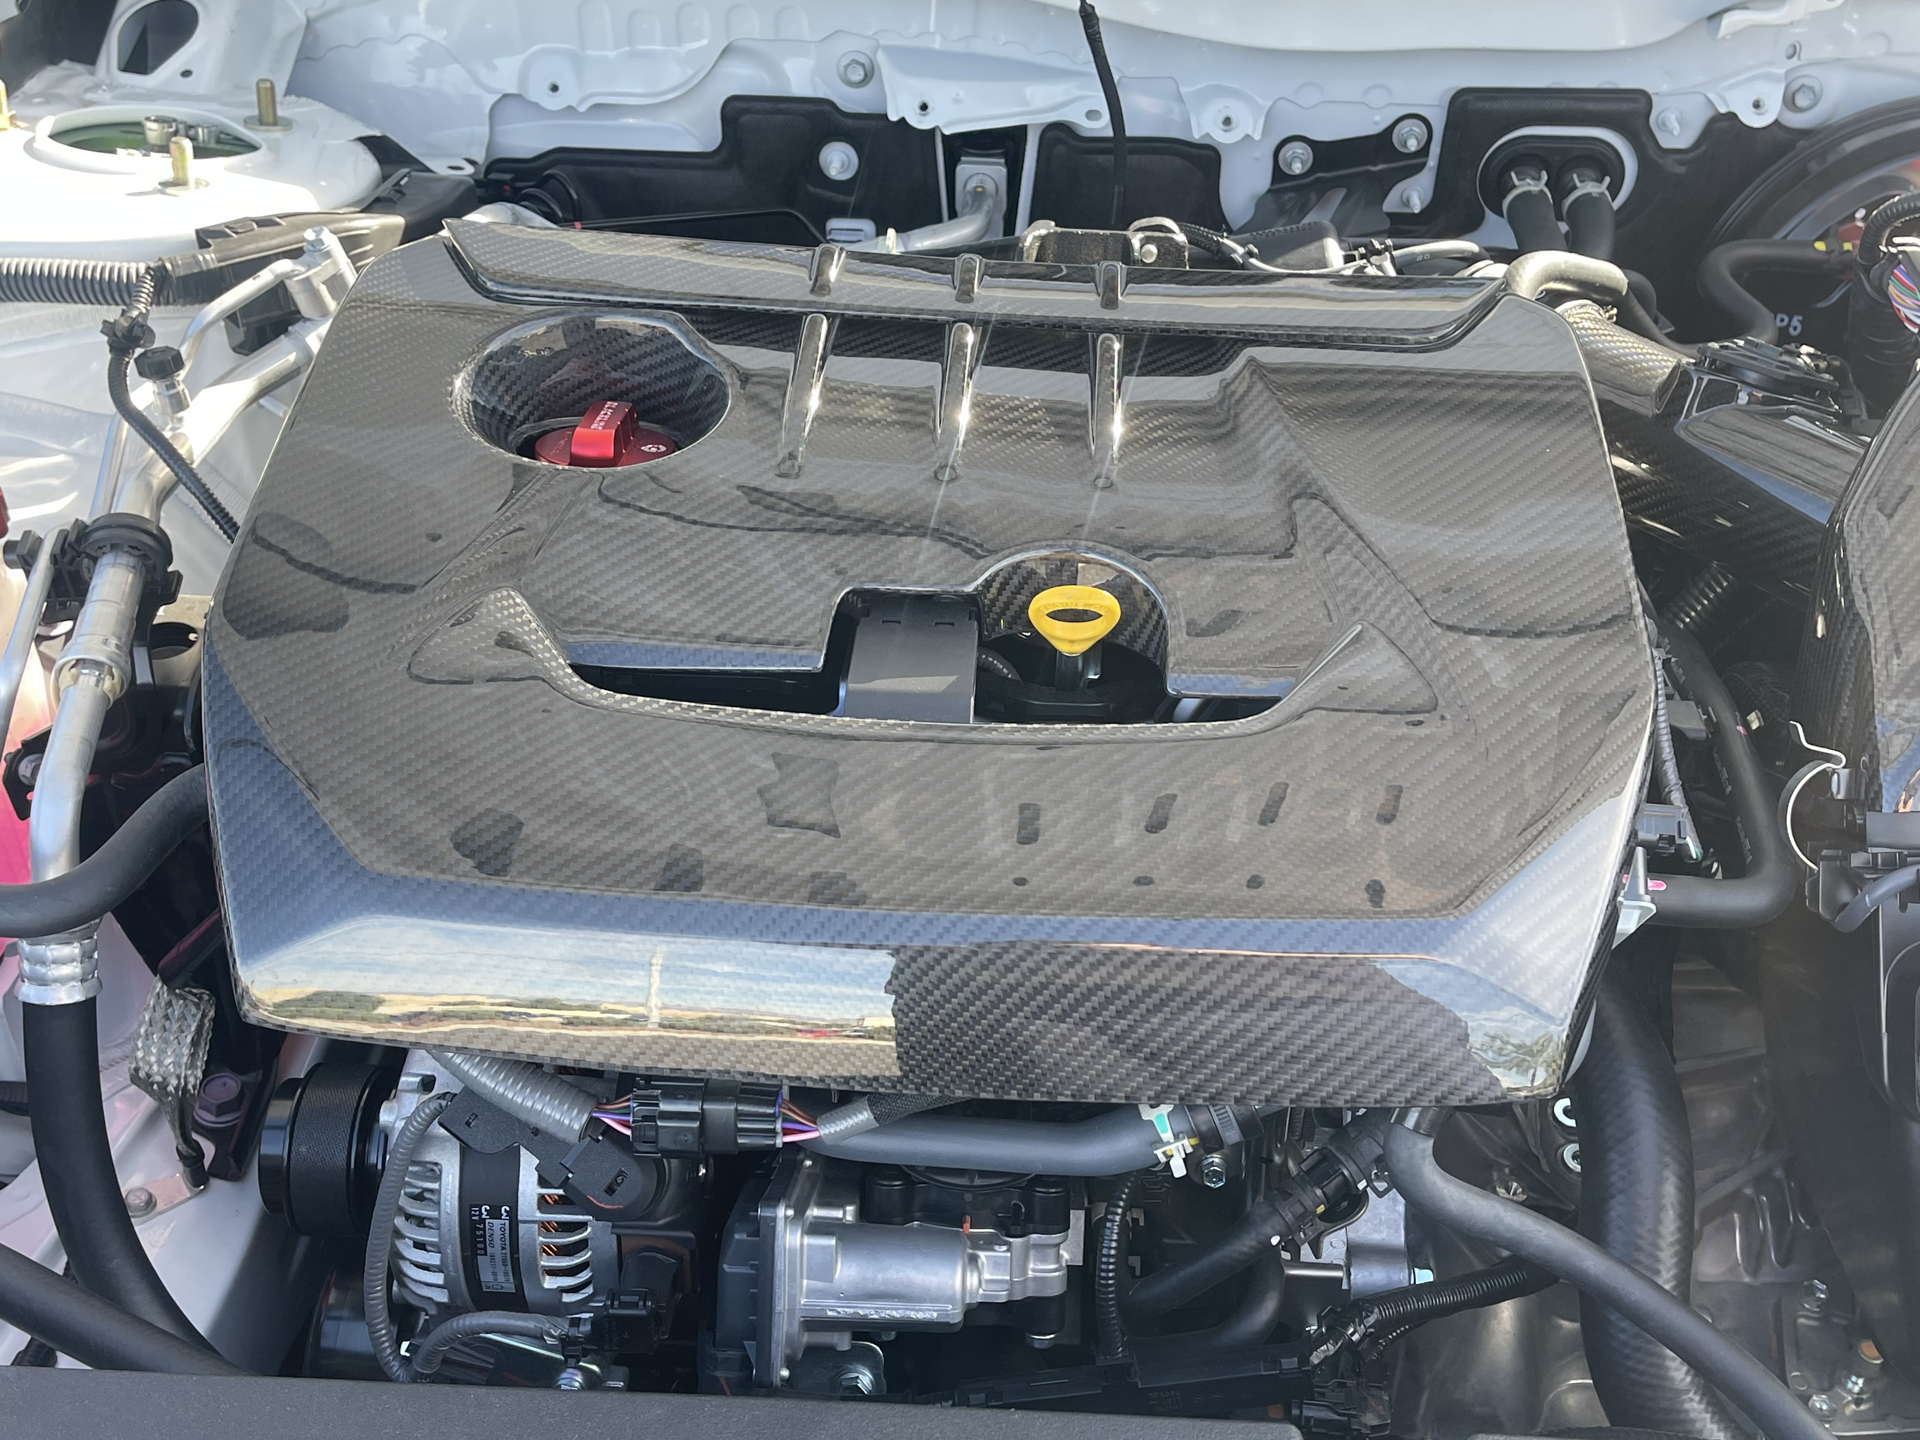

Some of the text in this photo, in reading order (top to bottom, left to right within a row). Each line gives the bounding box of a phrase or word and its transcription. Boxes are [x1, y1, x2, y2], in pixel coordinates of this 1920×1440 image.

[1039, 602, 1085, 612] ENGINE
[471, 1207, 479, 1220] 12V
[476, 1224, 484, 1255] 75100
[499, 1222, 507, 1251] TOYOTA
